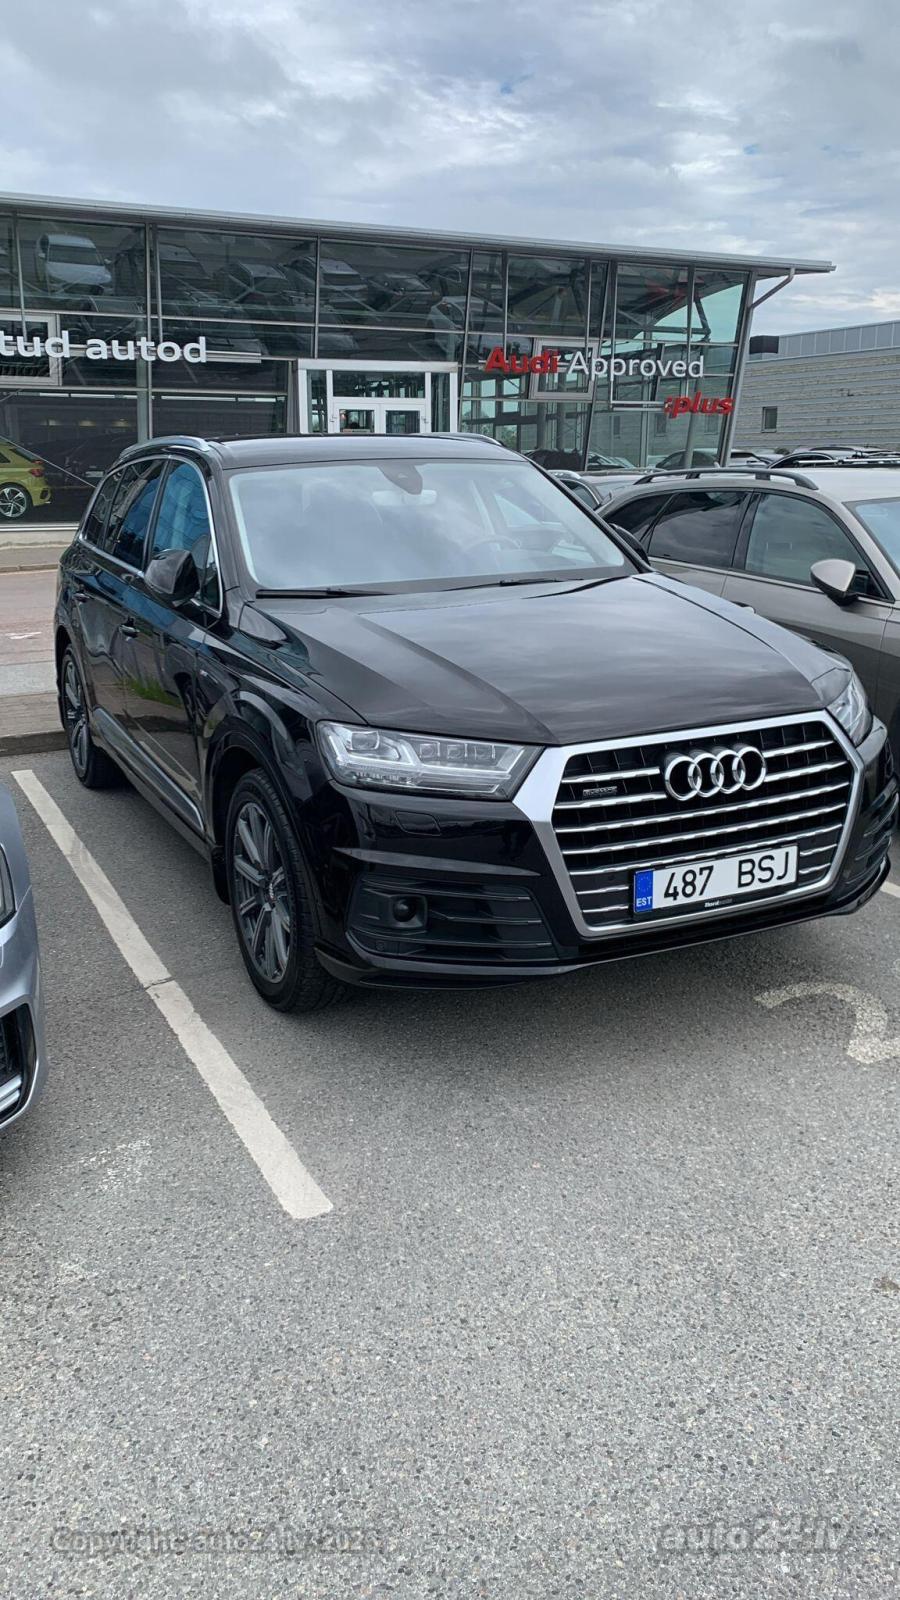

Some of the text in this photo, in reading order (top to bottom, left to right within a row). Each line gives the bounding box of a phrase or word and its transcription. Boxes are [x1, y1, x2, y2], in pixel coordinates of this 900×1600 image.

[86, 336, 206, 363] autod
[484, 346, 705, 381] Audi Approved
[664, 852, 789, 901] 487 BSJ
[636, 896, 652, 907] EST
